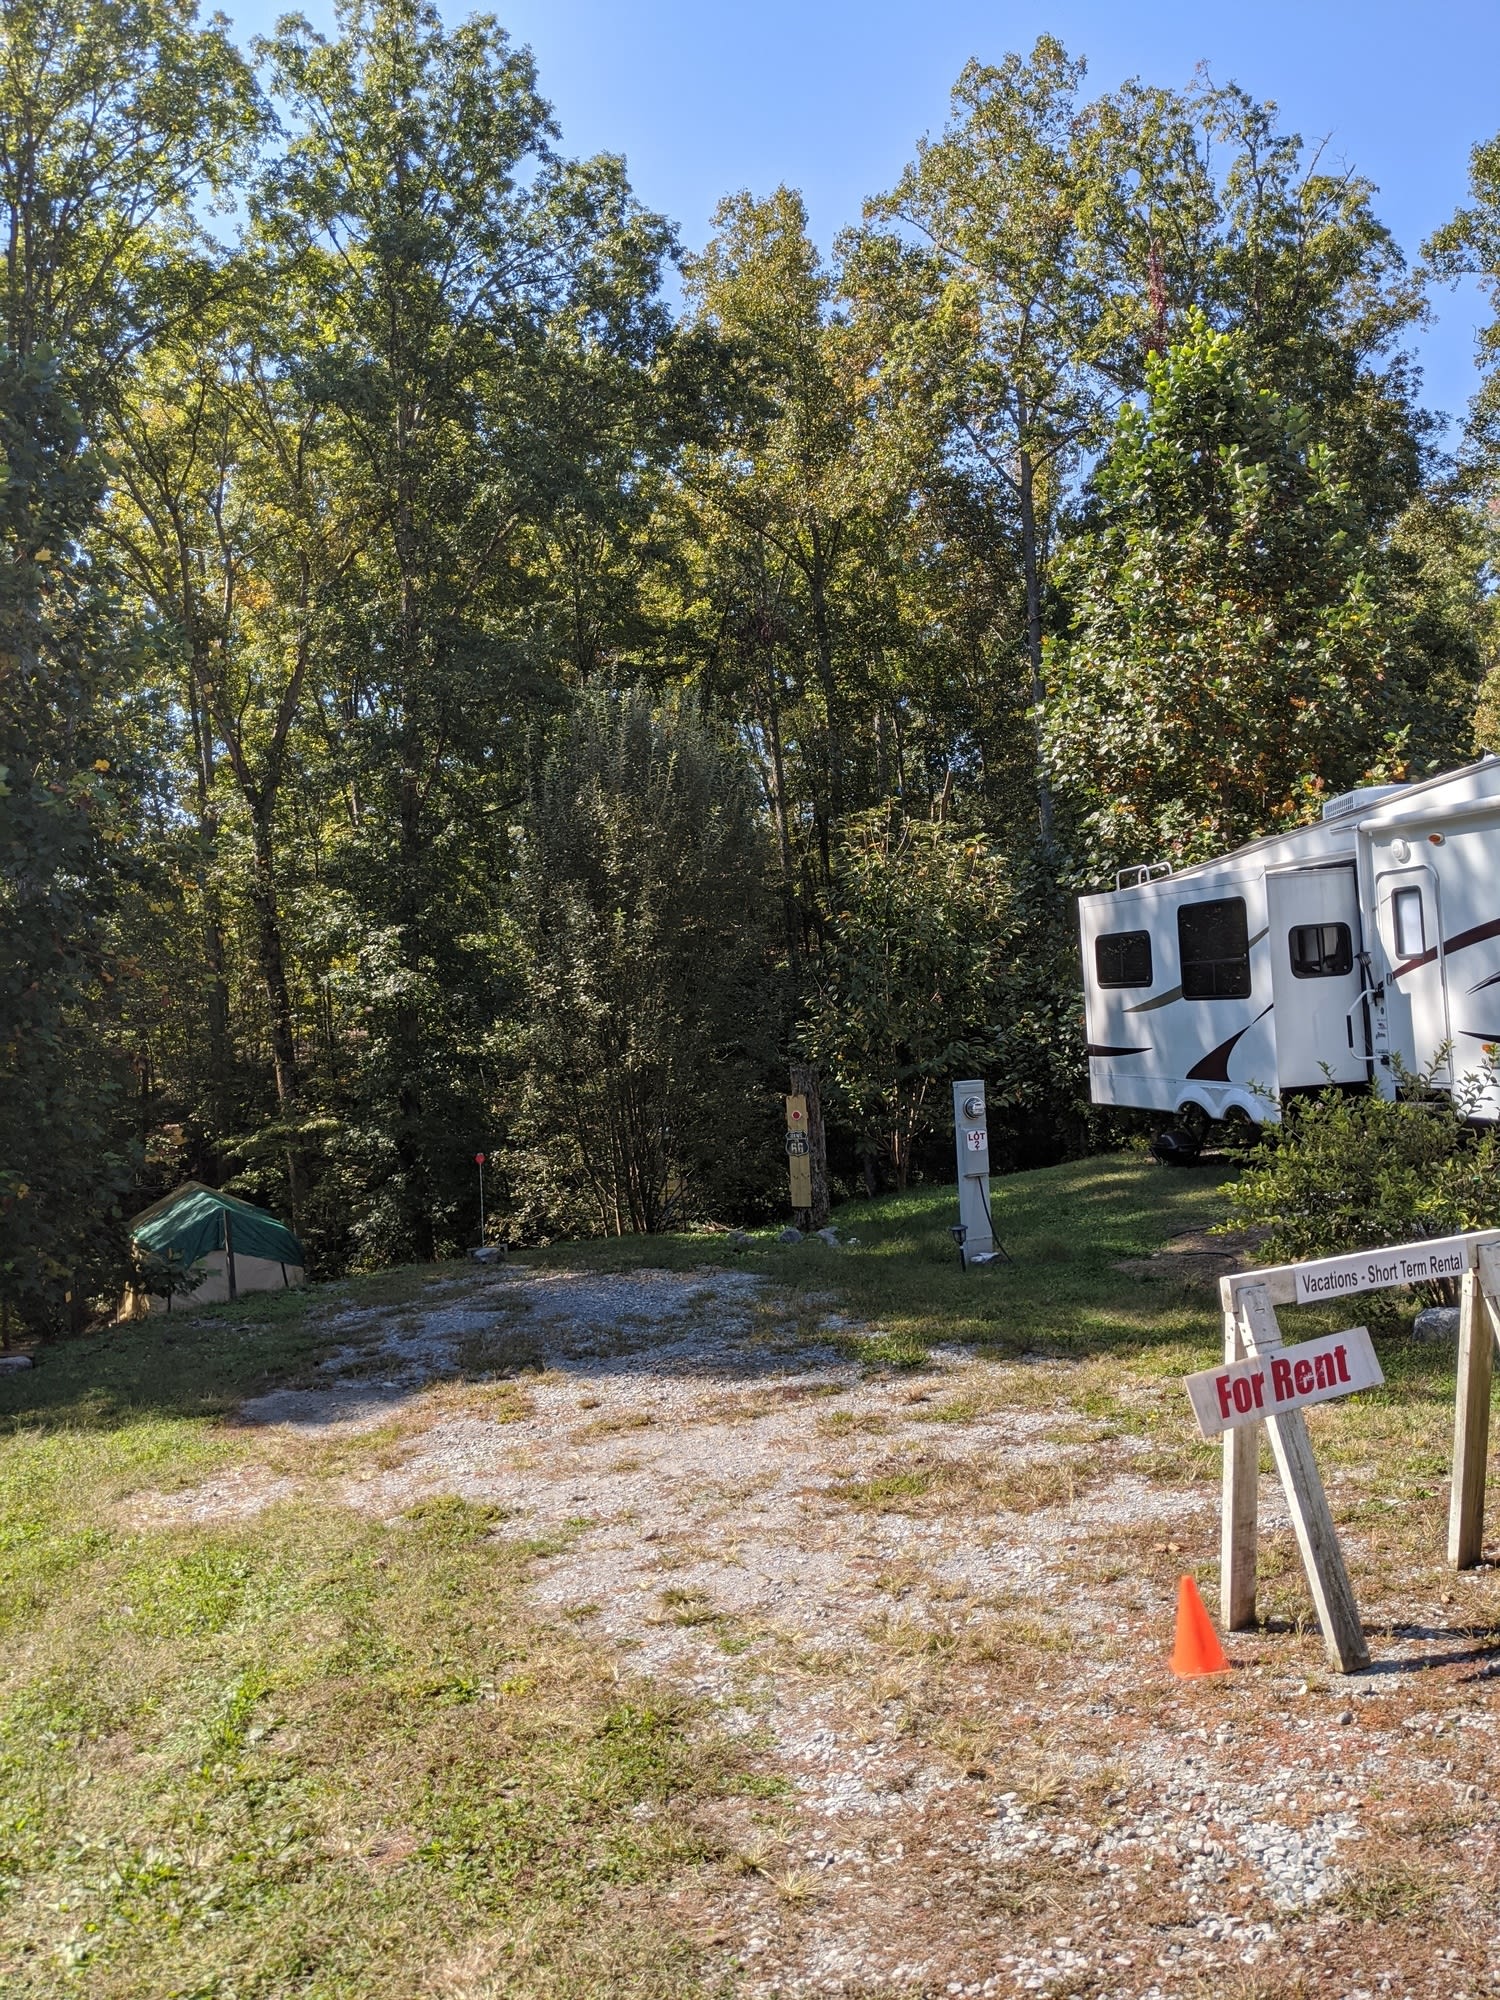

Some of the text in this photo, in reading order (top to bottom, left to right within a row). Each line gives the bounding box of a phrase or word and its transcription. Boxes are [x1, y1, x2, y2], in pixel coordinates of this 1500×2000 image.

[791, 1142, 804, 1154] 66
[968, 1132, 985, 1141] LOT
[1302, 1271, 1358, 1293] Vacations
[1368, 1263, 1398, 1283] Short
[1399, 1260, 1428, 1278] Term
[1429, 1252, 1463, 1274] Rental
[1215, 1344, 1352, 1419] For Rent
